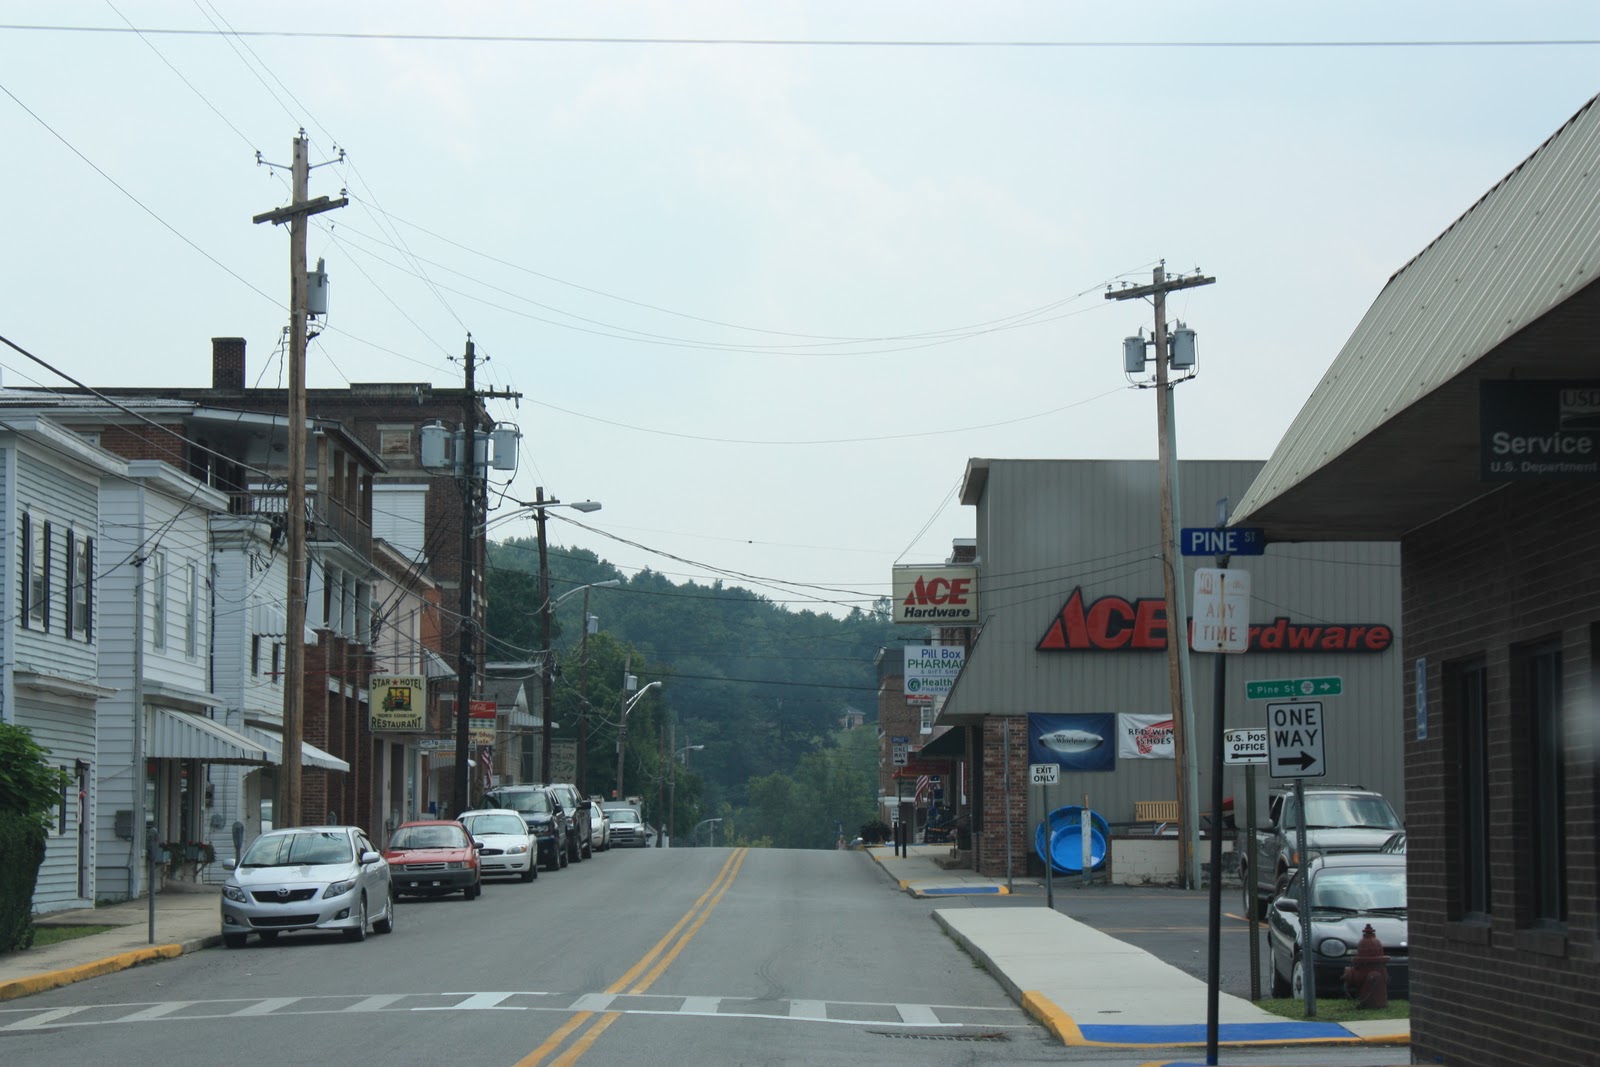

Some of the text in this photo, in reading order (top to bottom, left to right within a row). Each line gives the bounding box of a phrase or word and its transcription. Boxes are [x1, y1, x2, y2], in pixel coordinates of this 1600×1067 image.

[1562, 391, 1600, 406] USD
[1493, 432, 1593, 454] Service
[1490, 461, 1598, 475] U.S. Department
[1192, 531, 1256, 552] PINE ST
[903, 574, 971, 606] ACE
[904, 606, 970, 618] Hardware
[1038, 586, 1168, 650] ACE
[1203, 625, 1238, 642] TIME
[921, 649, 961, 659] Pill Box
[908, 659, 966, 669] PHARMAC
[372, 678, 422, 690] STAR HOTEL
[1257, 686, 1280, 694] Pine
[1284, 684, 1296, 693] St
[371, 716, 422, 729] RESTAURANT
[1274, 708, 1317, 727] ONE
[1128, 728, 1174, 736] RED WIN
[1226, 734, 1266, 742] U.S. POS
[1140, 737, 1171, 746] SHOES
[1275, 729, 1318, 748] WAY
[1233, 742, 1266, 751] OFFICE
[1035, 766, 1052, 775] EXIT
[1033, 774, 1056, 783] ONLY
